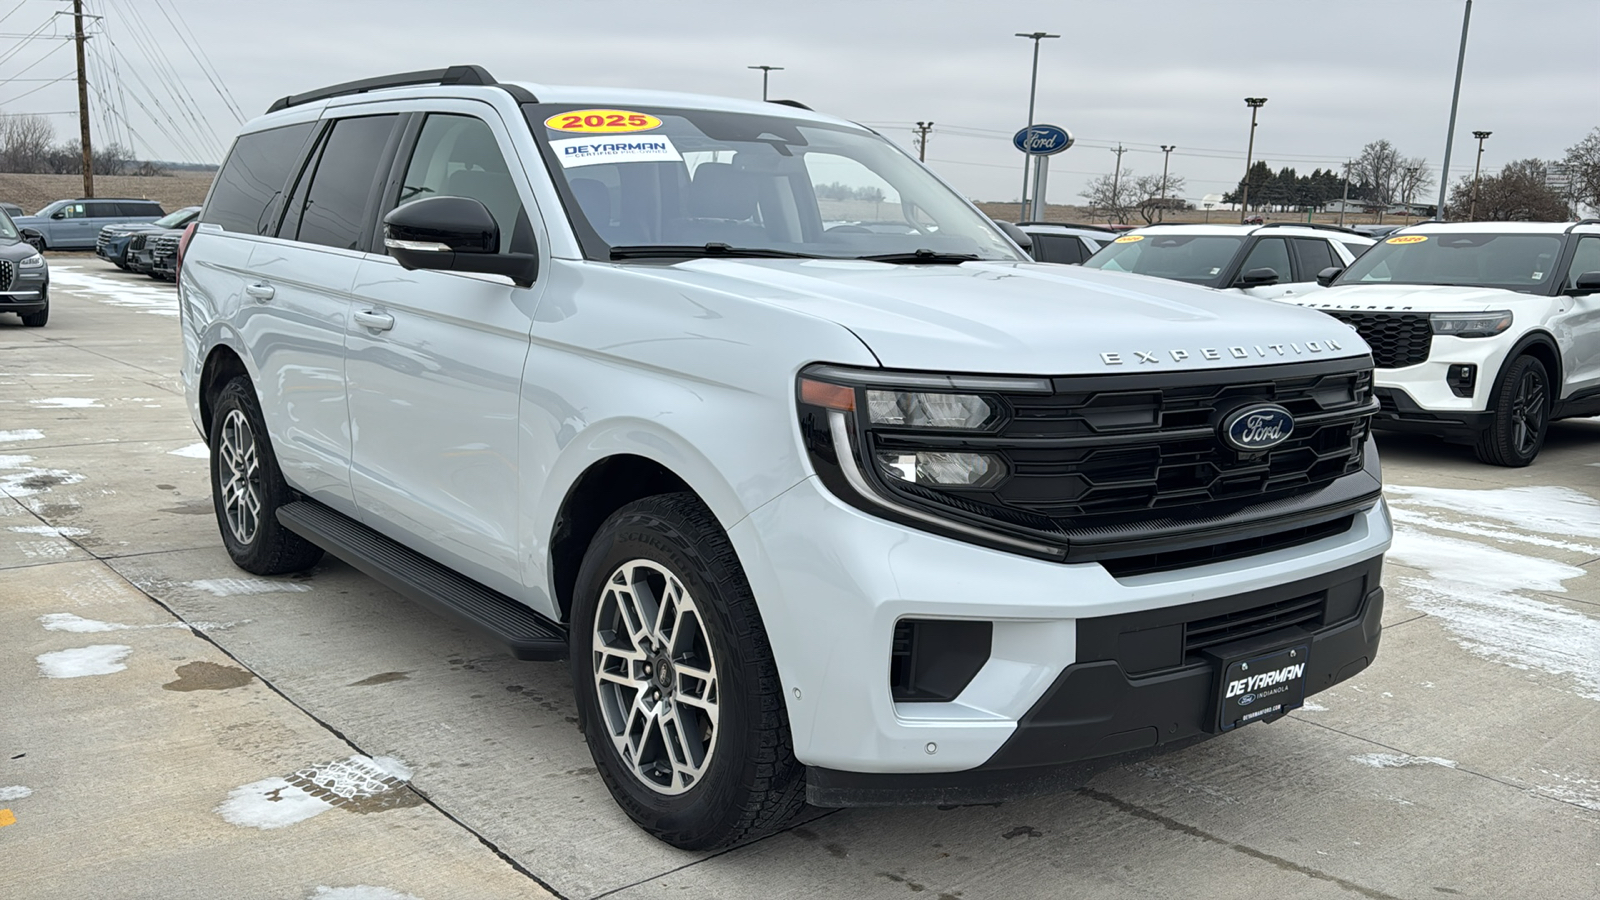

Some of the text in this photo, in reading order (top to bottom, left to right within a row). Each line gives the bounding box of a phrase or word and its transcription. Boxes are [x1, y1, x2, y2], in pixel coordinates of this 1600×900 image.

[562, 114, 648, 129] 2025
[564, 142, 666, 155] DEYARMAN
[1023, 130, 1058, 149] Ford
[1099, 338, 1343, 366] EXPEDITION
[1242, 413, 1284, 443] Ford
[617, 531, 698, 587] SCORPION
[1226, 663, 1305, 698] DEYARMAN
[1257, 685, 1289, 699] INDIANOLA
